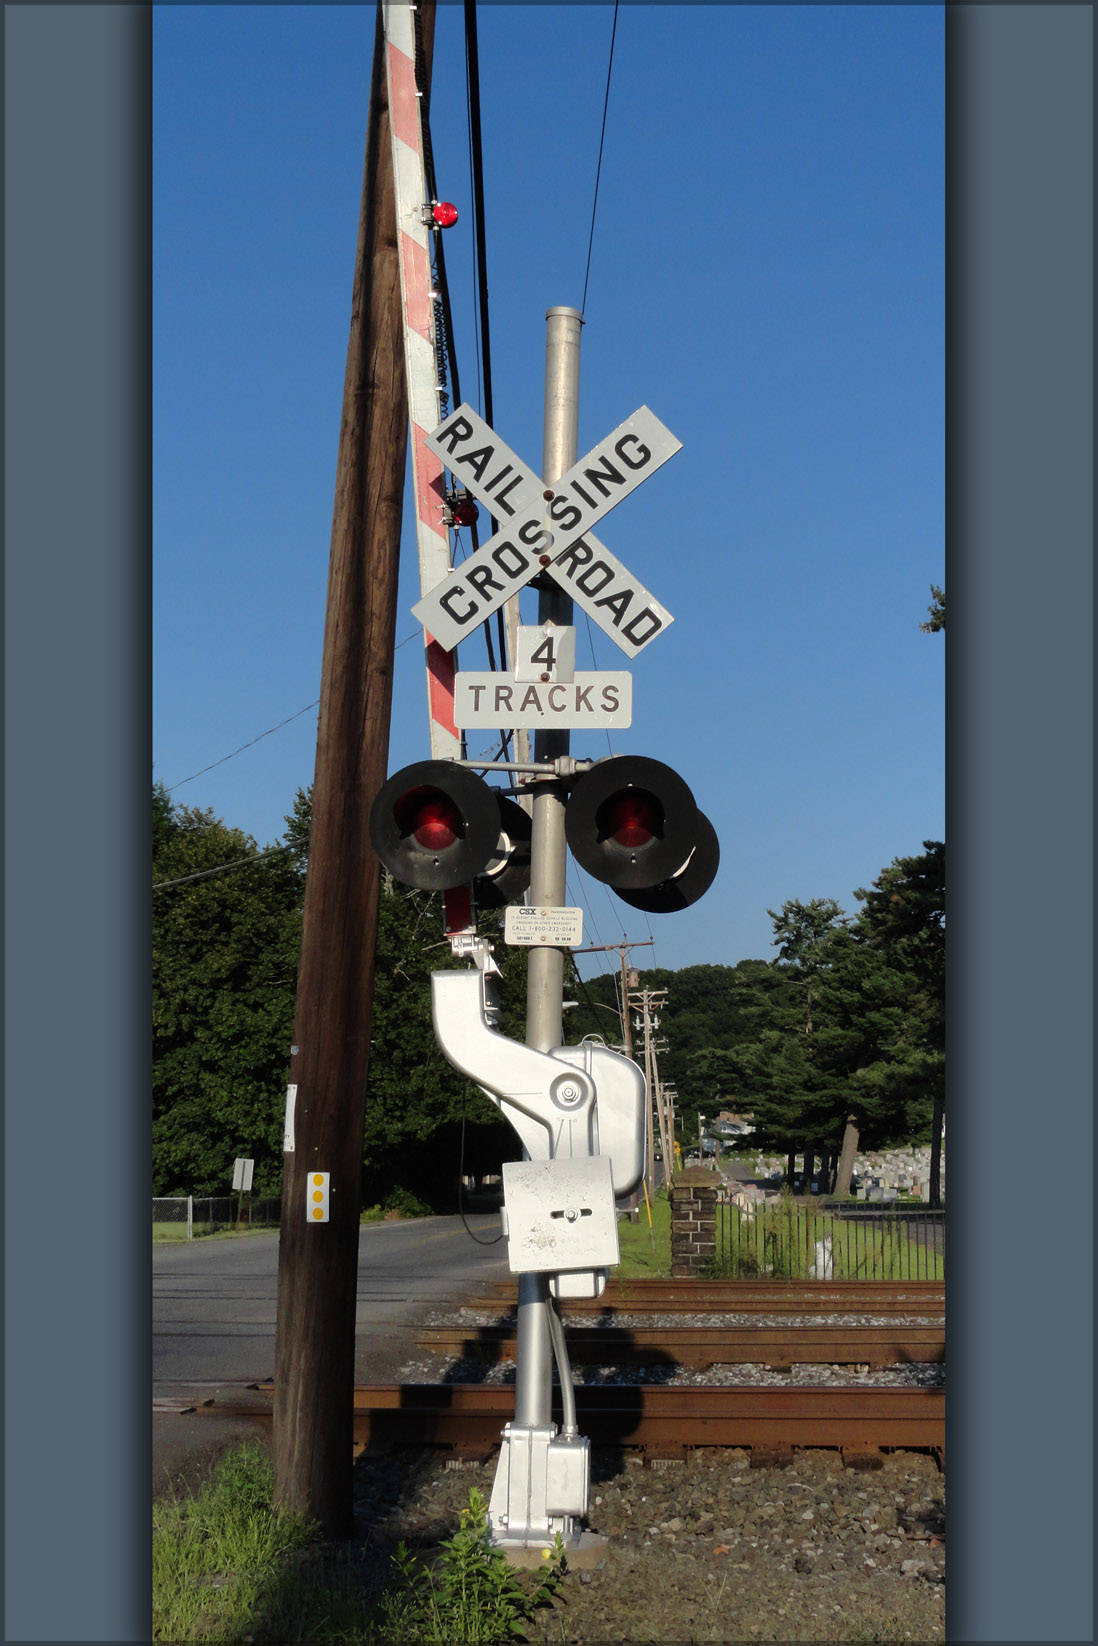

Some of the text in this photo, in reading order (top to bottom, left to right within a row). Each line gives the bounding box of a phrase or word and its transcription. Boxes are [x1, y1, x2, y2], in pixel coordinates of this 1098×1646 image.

[436, 415, 663, 647] RAIL ROAD
[439, 433, 651, 625] CROSSING
[468, 685, 620, 713] TRACKS
[530, 636, 556, 672] 4
